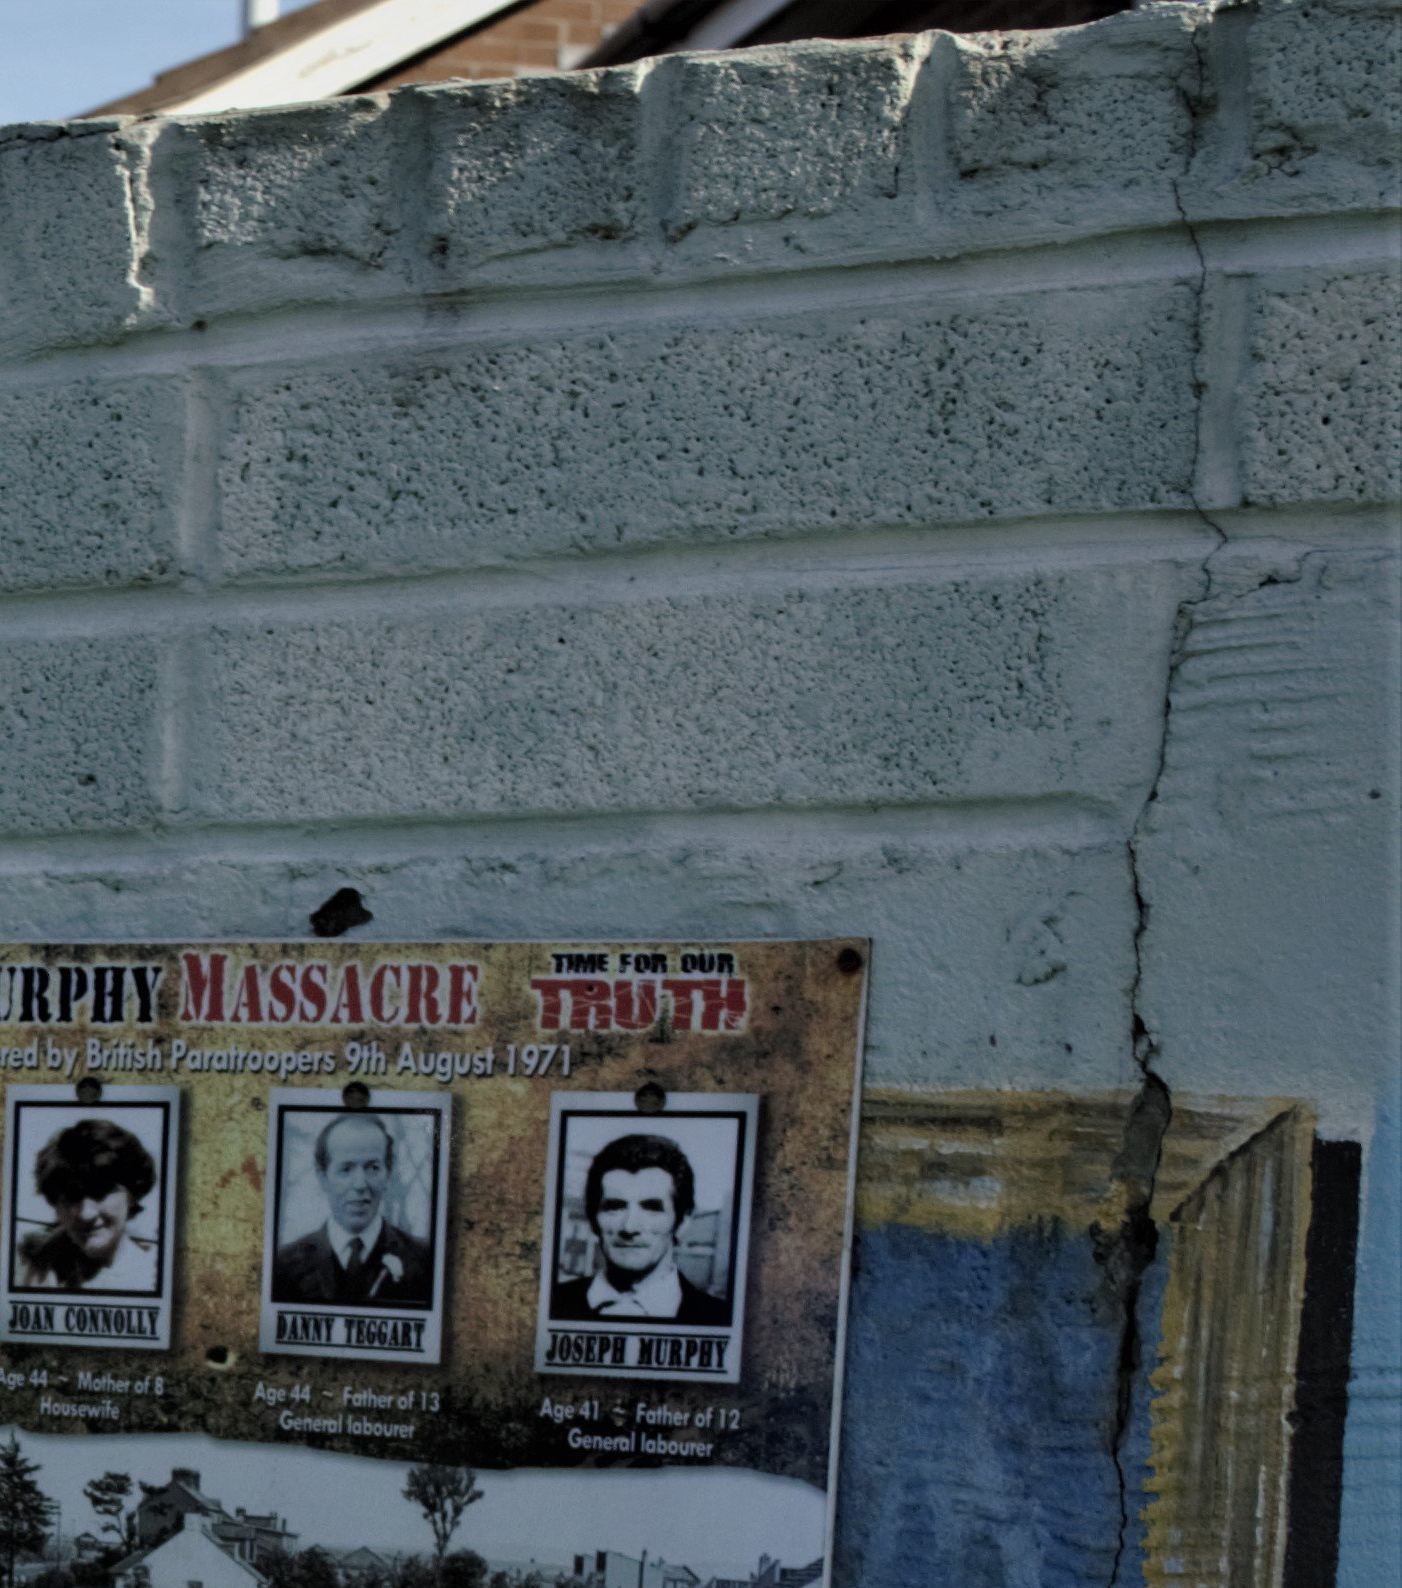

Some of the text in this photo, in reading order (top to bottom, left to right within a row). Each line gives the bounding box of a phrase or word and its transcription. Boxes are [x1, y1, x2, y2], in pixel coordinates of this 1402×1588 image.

[551, 952, 735, 975] TIME FOR OUR
[180, 953, 479, 1026] MASSACRE
[530, 977, 748, 1032] TRUTH
[46, 1038, 79, 1077] by
[85, 1038, 163, 1073] British
[169, 1039, 336, 1080] Paratroopers
[344, 1041, 387, 1076] 9th
[395, 1041, 495, 1083] August
[505, 1043, 574, 1078] 1971
[8, 1303, 161, 1336] JOAN CONNOLLY
[276, 1313, 426, 1349] DANNY TEGGART
[546, 1332, 730, 1369] JOSEPH MURPHY
[29, 1368, 48, 1388] 44
[77, 1370, 130, 1394] Mother
[134, 1375, 151, 1395] of
[154, 1376, 165, 1396] 8
[253, 1381, 286, 1406] Age
[290, 1382, 312, 1404] 44
[342, 1385, 394, 1410] Father
[397, 1391, 416, 1411] of
[421, 1391, 441, 1413] 13
[39, 1396, 121, 1420] Housewife
[278, 1409, 416, 1440] General labourer
[540, 1397, 576, 1424] Age
[579, 1399, 600, 1422] 41
[635, 1401, 690, 1427] Father
[694, 1407, 715, 1429] of
[720, 1408, 741, 1430] 12
[568, 1427, 714, 1458] General labourer
